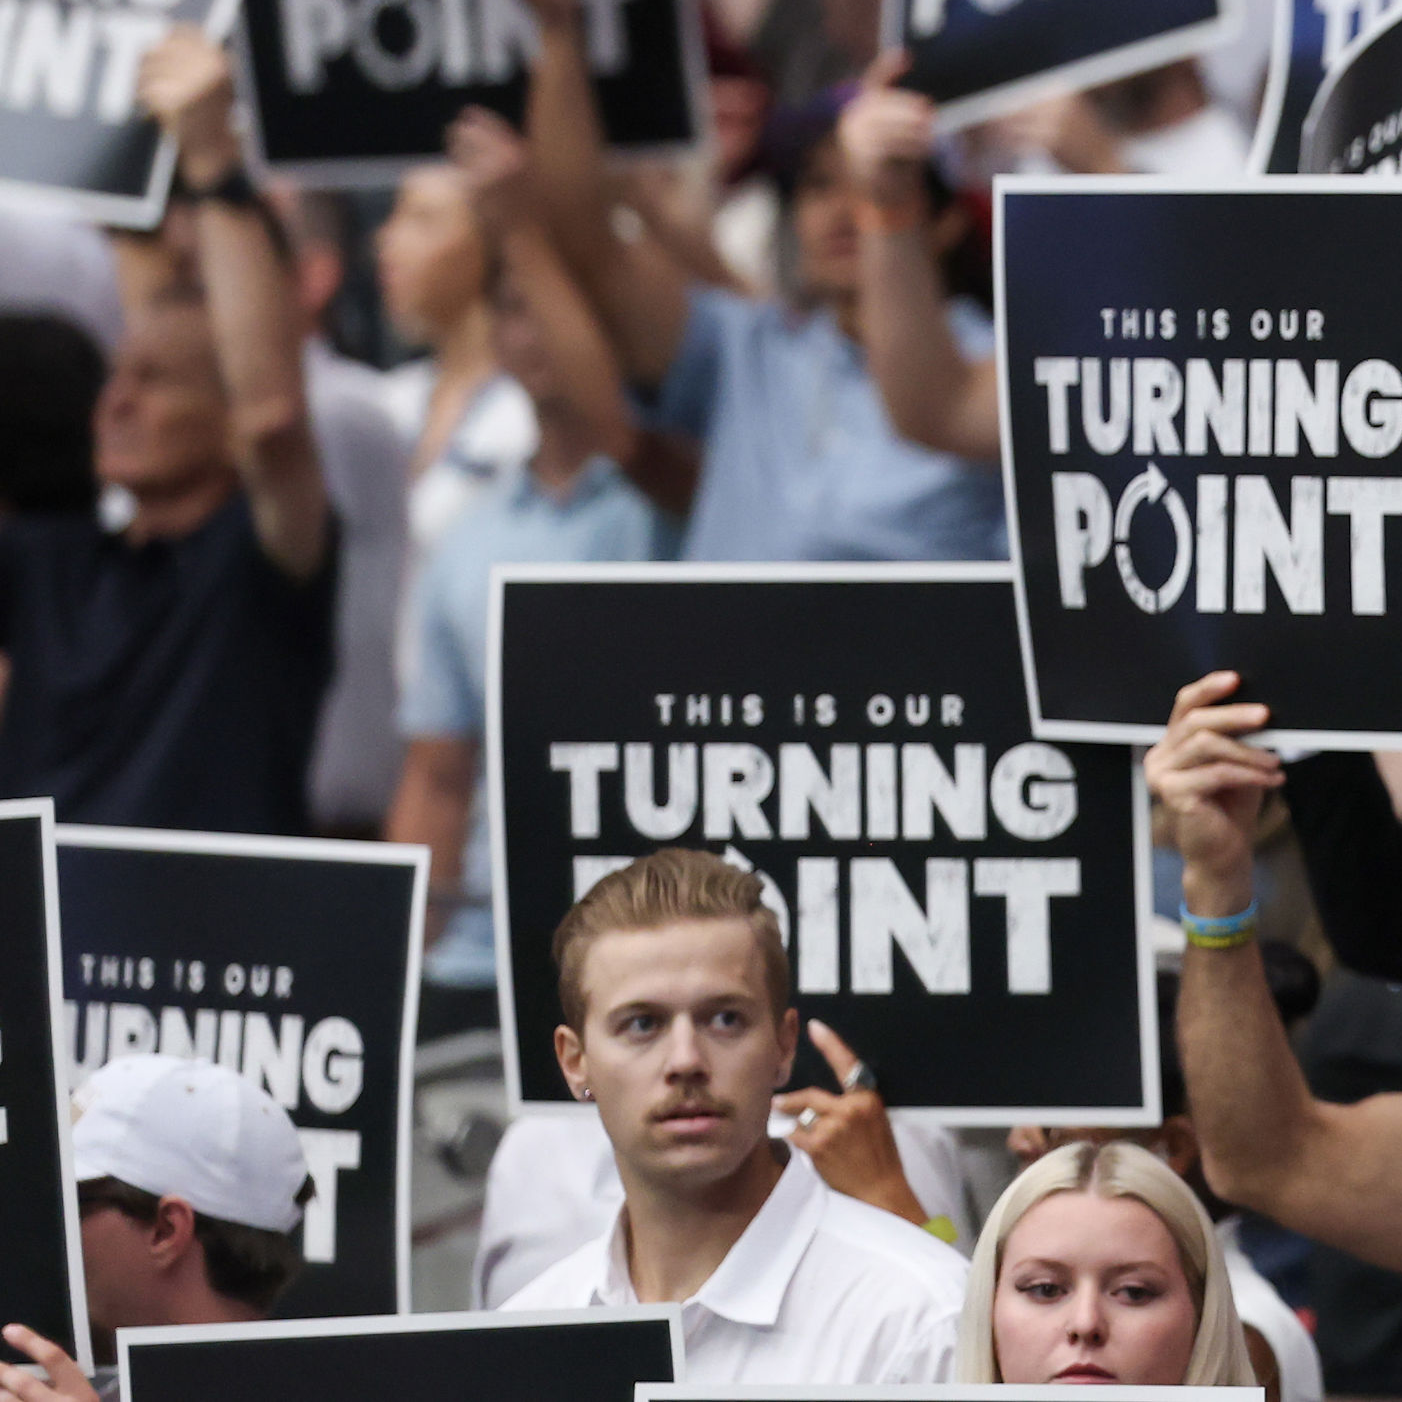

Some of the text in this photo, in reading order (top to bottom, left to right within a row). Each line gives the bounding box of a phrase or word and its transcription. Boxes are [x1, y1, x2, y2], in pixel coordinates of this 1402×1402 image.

[1100, 308, 1325, 341] THIS IS OUR
[656, 694, 965, 726] THIS IS OUR
[550, 742, 1077, 841] TURNING
[81, 953, 295, 998] THIS IS OUR
[63, 1000, 364, 1115] URNING
